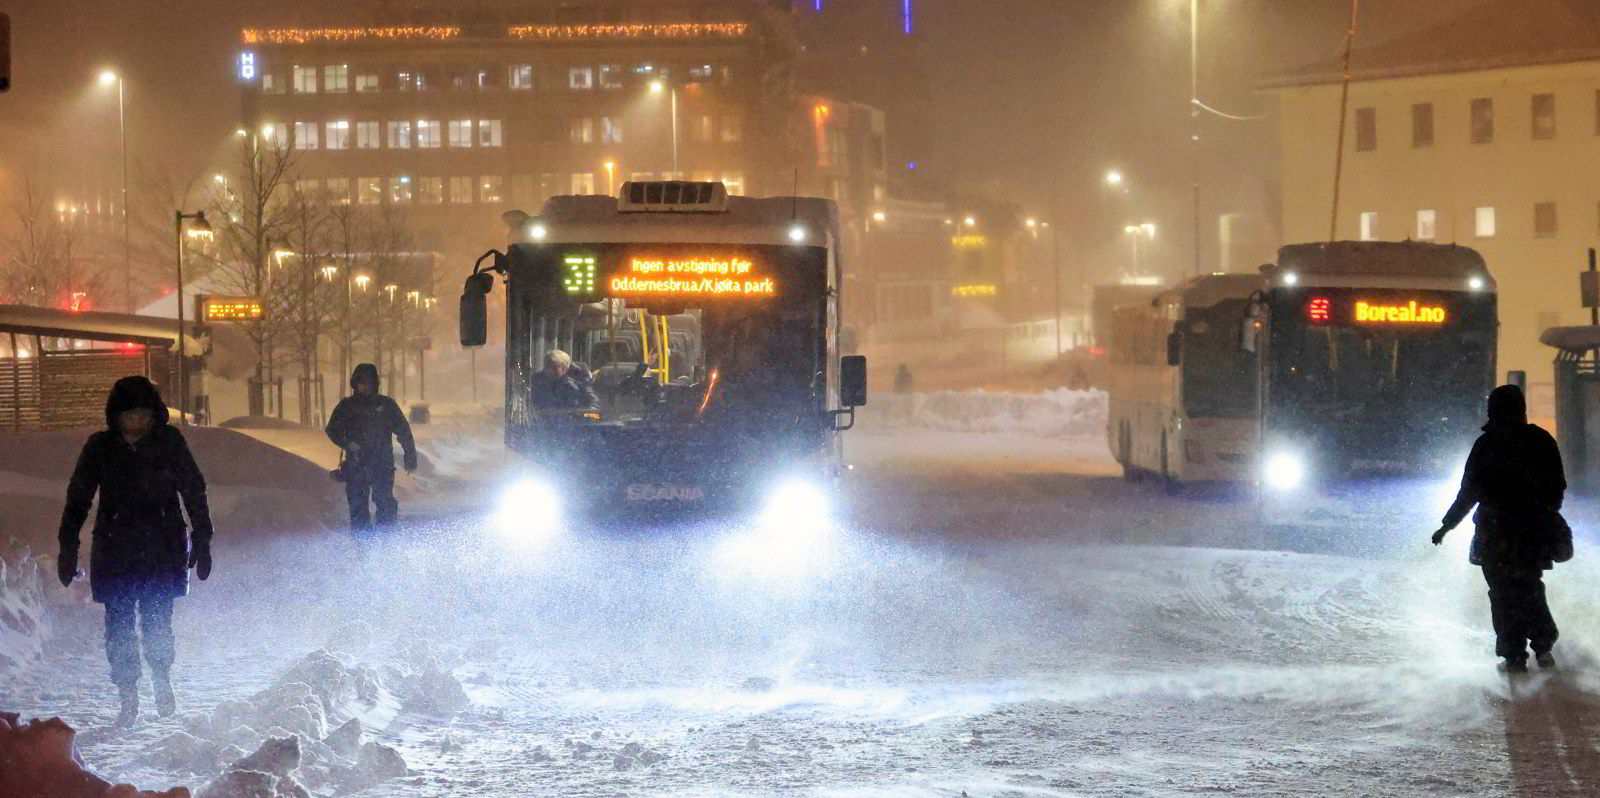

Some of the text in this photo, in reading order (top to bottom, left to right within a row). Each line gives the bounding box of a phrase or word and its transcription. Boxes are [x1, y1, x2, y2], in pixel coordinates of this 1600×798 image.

[632, 258, 752, 274] Ingen avstigning før
[744, 277, 774, 293] park
[1356, 300, 1445, 322] Boreal.no
[626, 483, 705, 501] SCANIA
